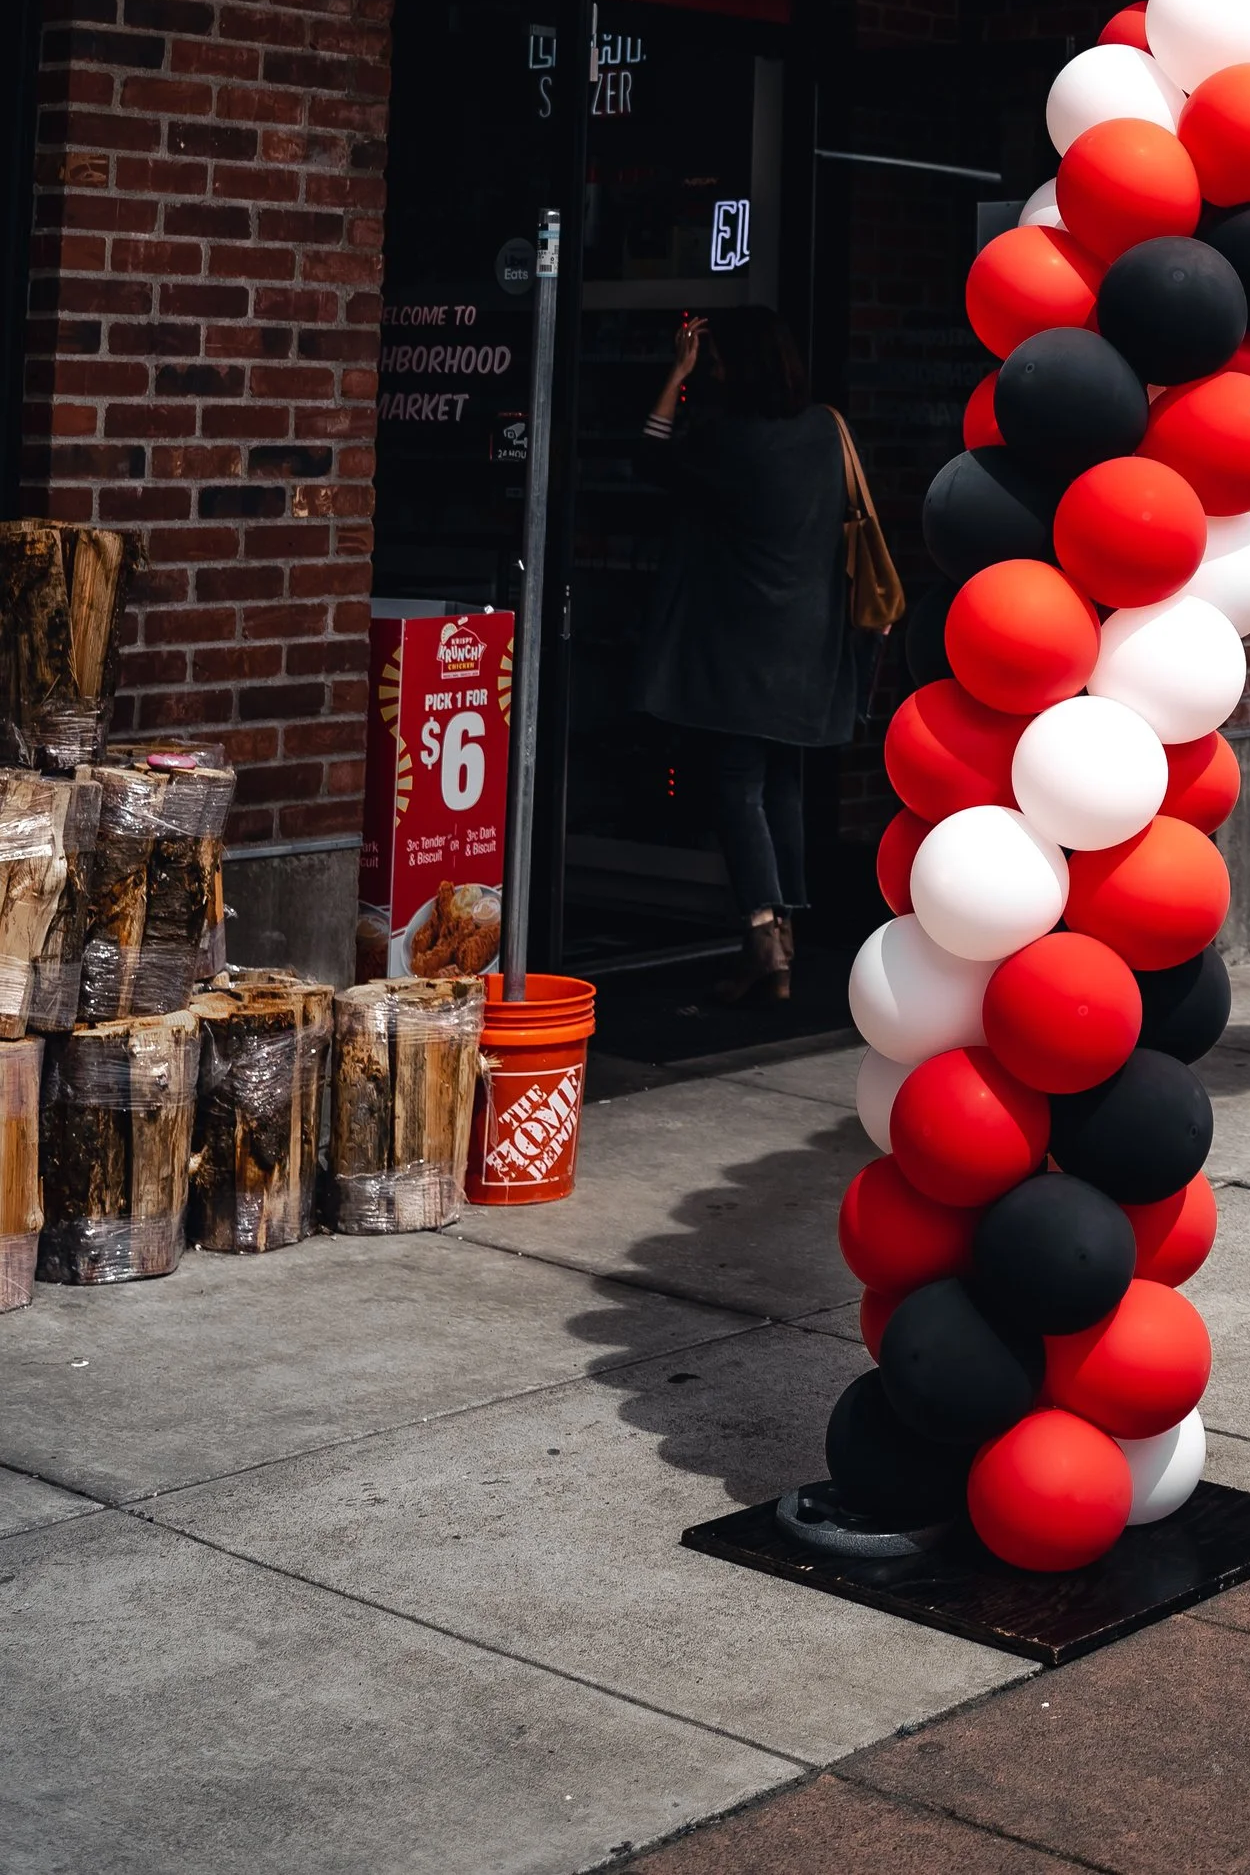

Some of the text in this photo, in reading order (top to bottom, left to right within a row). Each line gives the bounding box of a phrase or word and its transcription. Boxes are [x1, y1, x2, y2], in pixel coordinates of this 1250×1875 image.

[504, 268, 529, 281] Eats
[381, 305, 477, 326] ELCOME TO
[380, 345, 512, 375] HBORHOOD
[439, 644, 485, 664] KRUNCHY
[425, 688, 488, 712] PICK 1 FOR
[420, 711, 486, 812] $6
[479, 826, 497, 840] Dark
[450, 840, 460, 852] OR
[465, 840, 497, 856] & Biscuit
[360, 856, 379, 869] cuit
[408, 849, 443, 867] & Biscuit
[498, 1083, 548, 1130] THE
[486, 1068, 579, 1178] HOME
